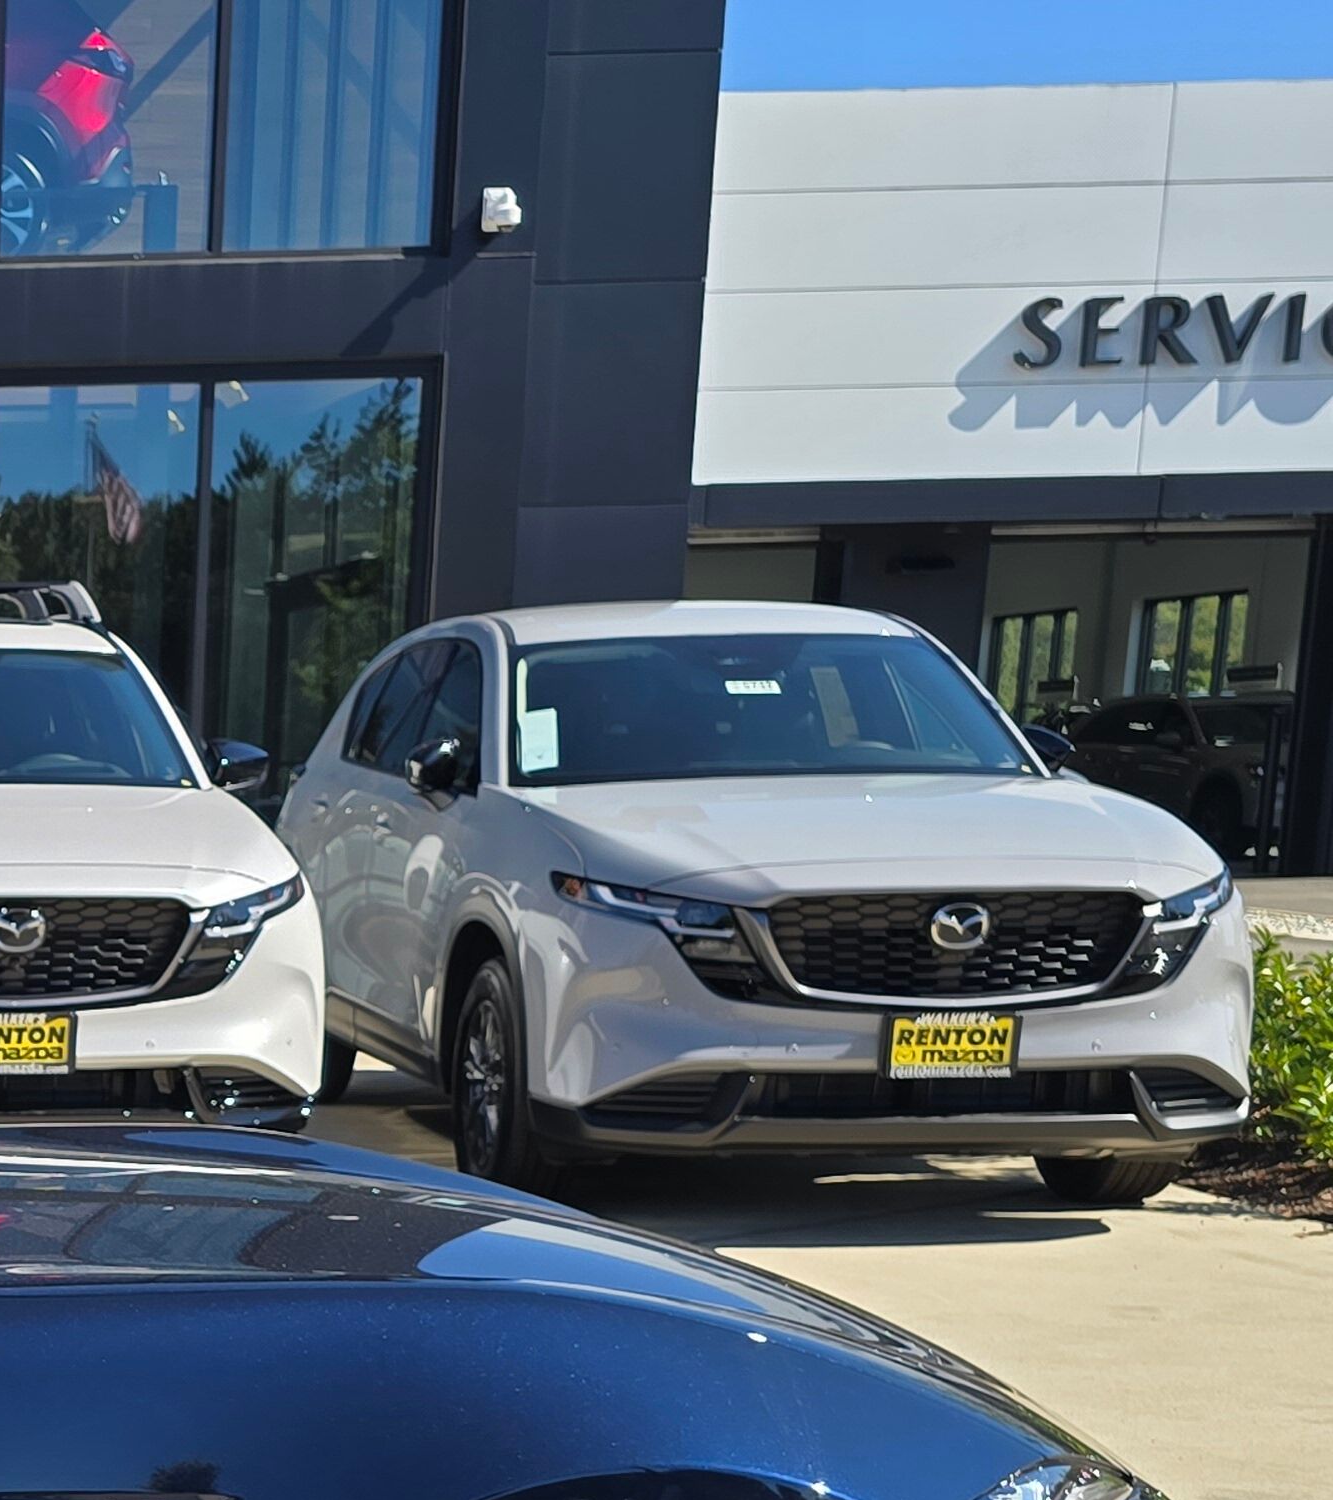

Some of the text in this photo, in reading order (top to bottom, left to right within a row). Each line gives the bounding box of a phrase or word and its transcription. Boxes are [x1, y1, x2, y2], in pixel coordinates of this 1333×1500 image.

[1012, 292, 1333, 370] SERVI
[896, 1028, 1009, 1046] RENTON
[921, 1049, 1004, 1062] mazda
